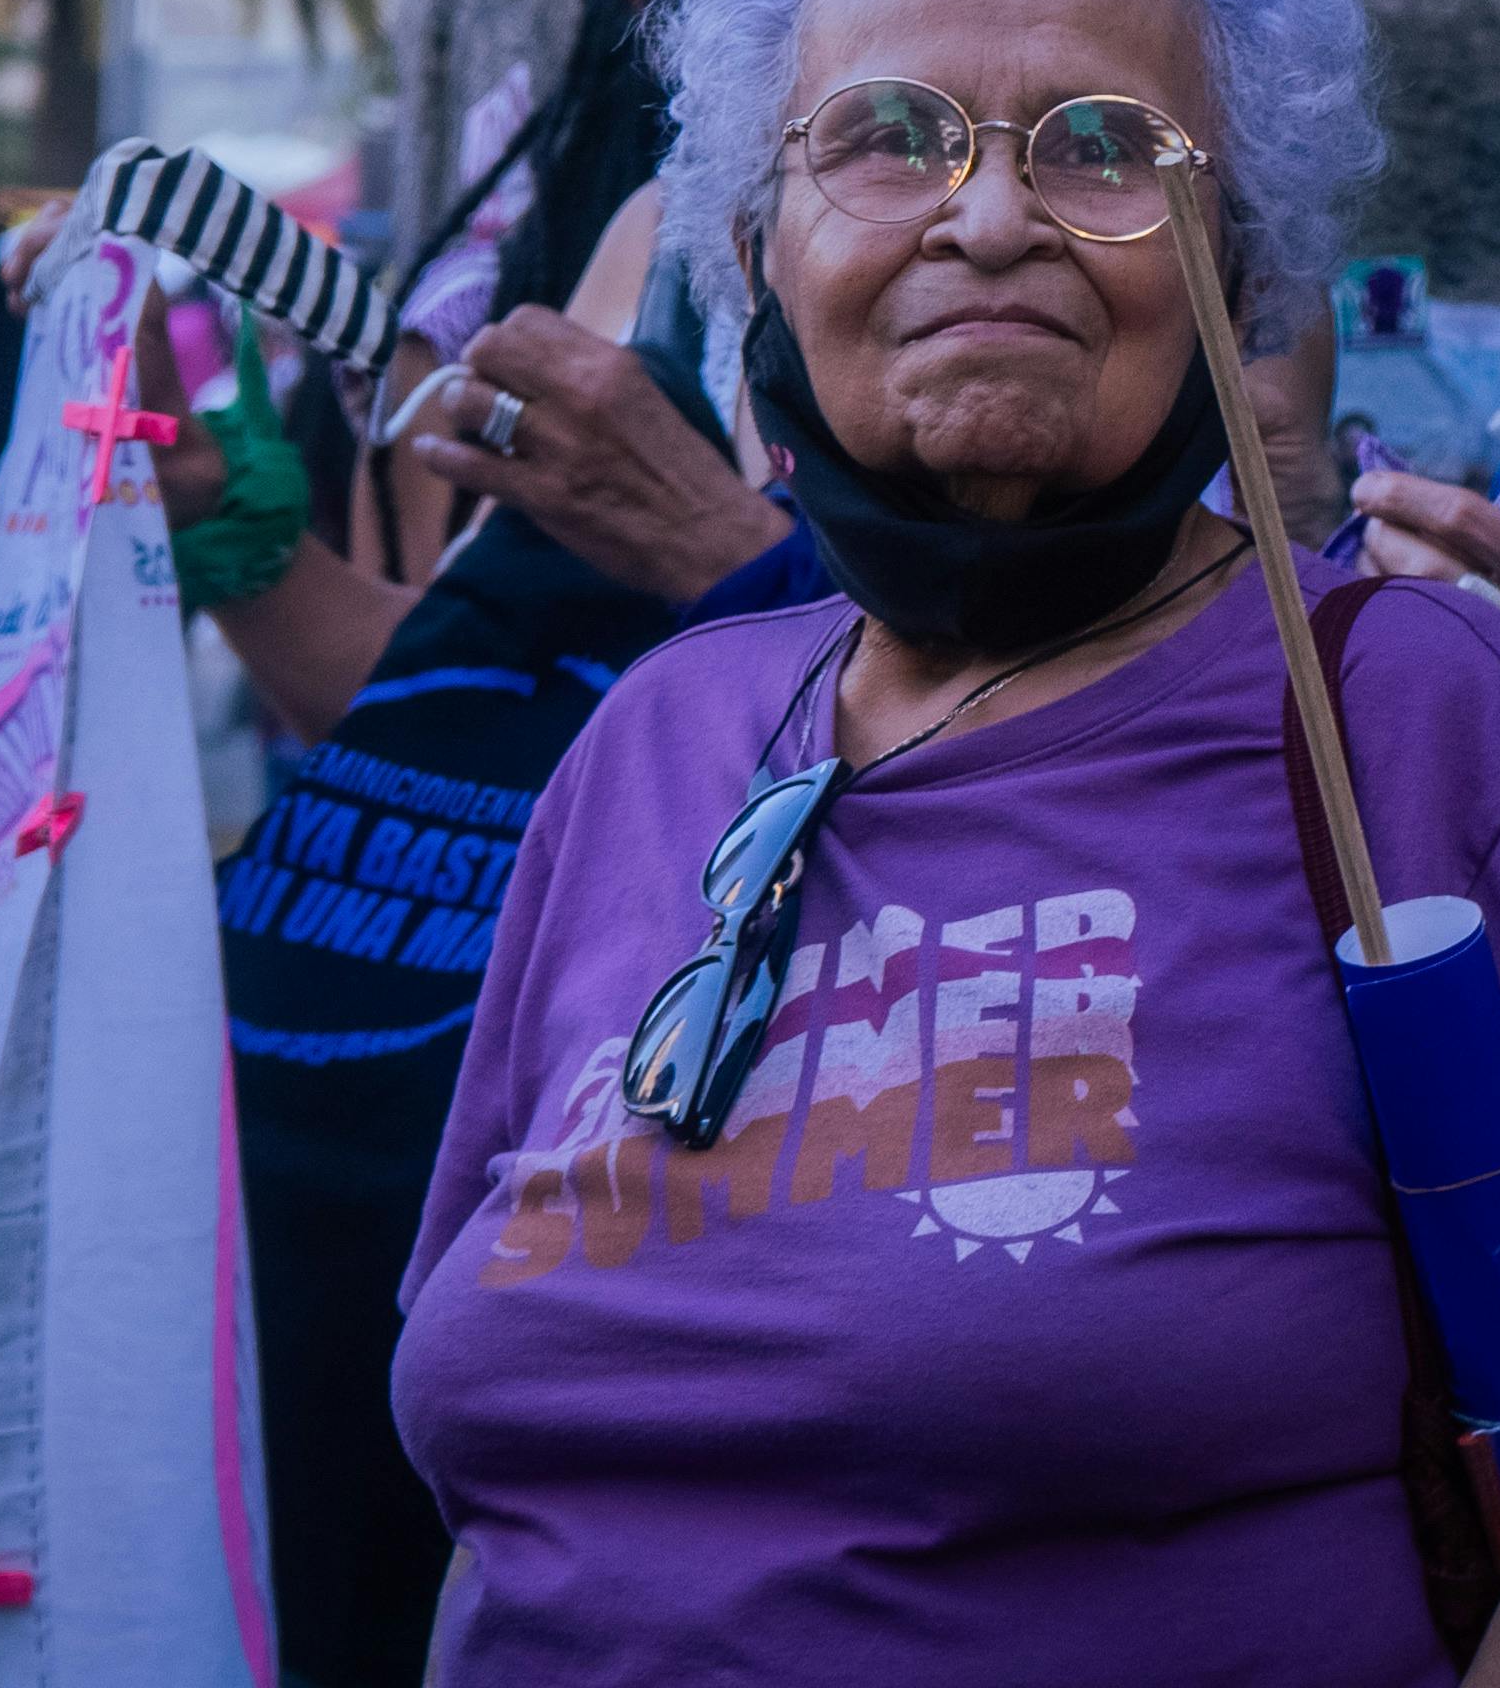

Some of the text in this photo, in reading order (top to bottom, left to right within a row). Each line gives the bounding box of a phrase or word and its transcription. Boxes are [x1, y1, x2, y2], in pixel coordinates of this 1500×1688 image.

[300, 741, 478, 822] EMINICIDIO
[355, 817, 518, 908] BAST
[218, 857, 501, 973] NI UNA MA
[477, 1052, 1141, 1290] SUMMER
